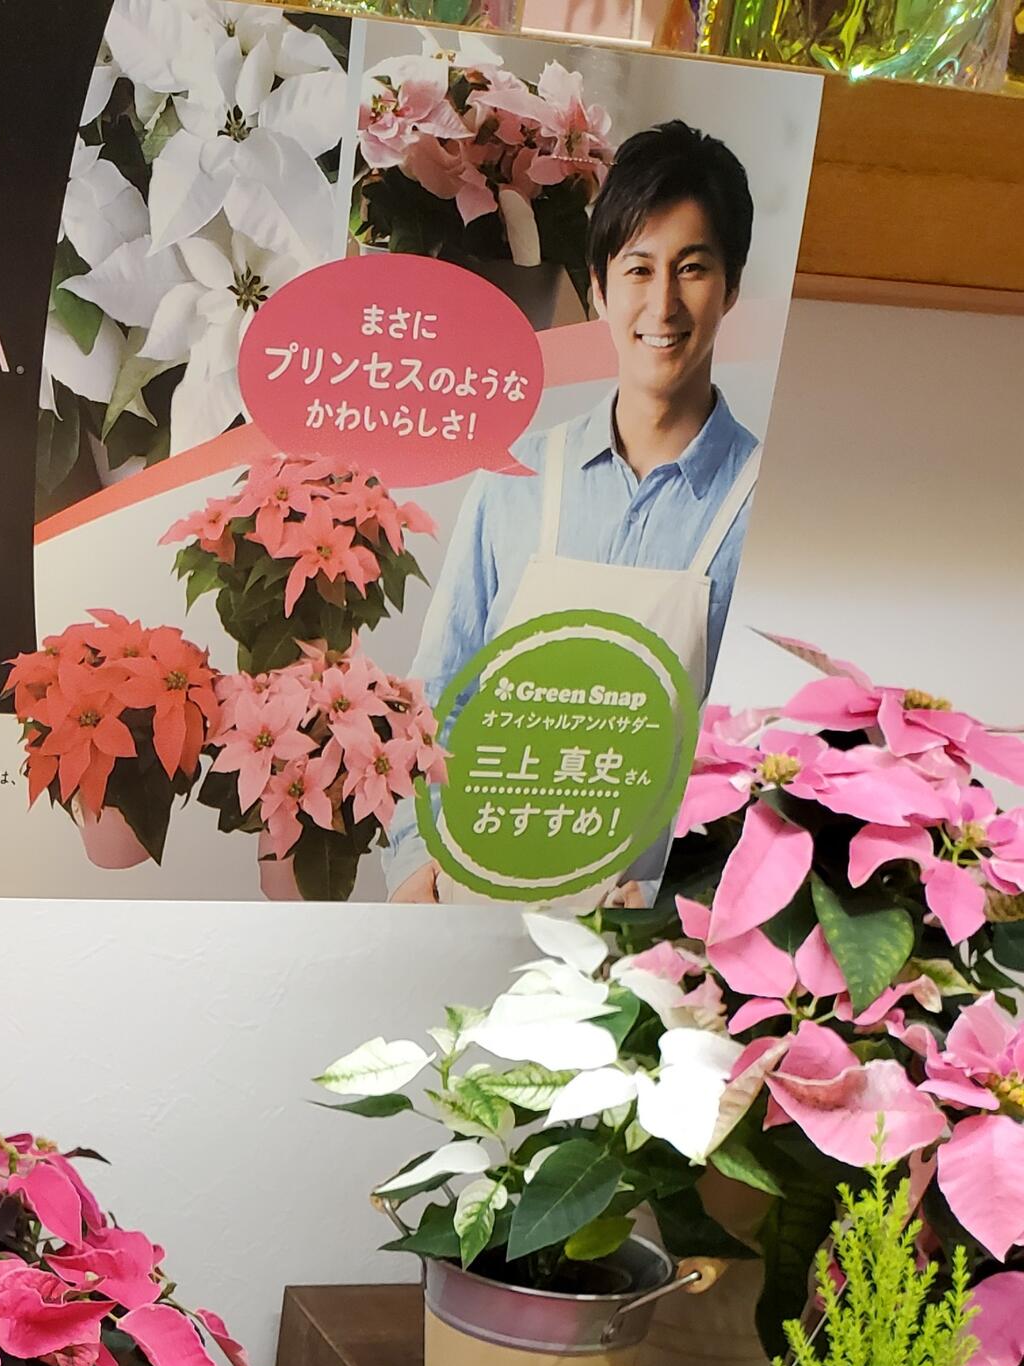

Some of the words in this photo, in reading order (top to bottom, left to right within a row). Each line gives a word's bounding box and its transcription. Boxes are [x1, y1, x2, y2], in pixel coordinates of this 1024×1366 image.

[362, 304, 437, 339] まさに
[265, 342, 528, 401] プリンセスのような
[516, 681, 586, 705] Green
[589, 686, 646, 710] Snap
[482, 710, 660, 734] オフィシャルアンバサダー
[469, 745, 541, 781] 三上
